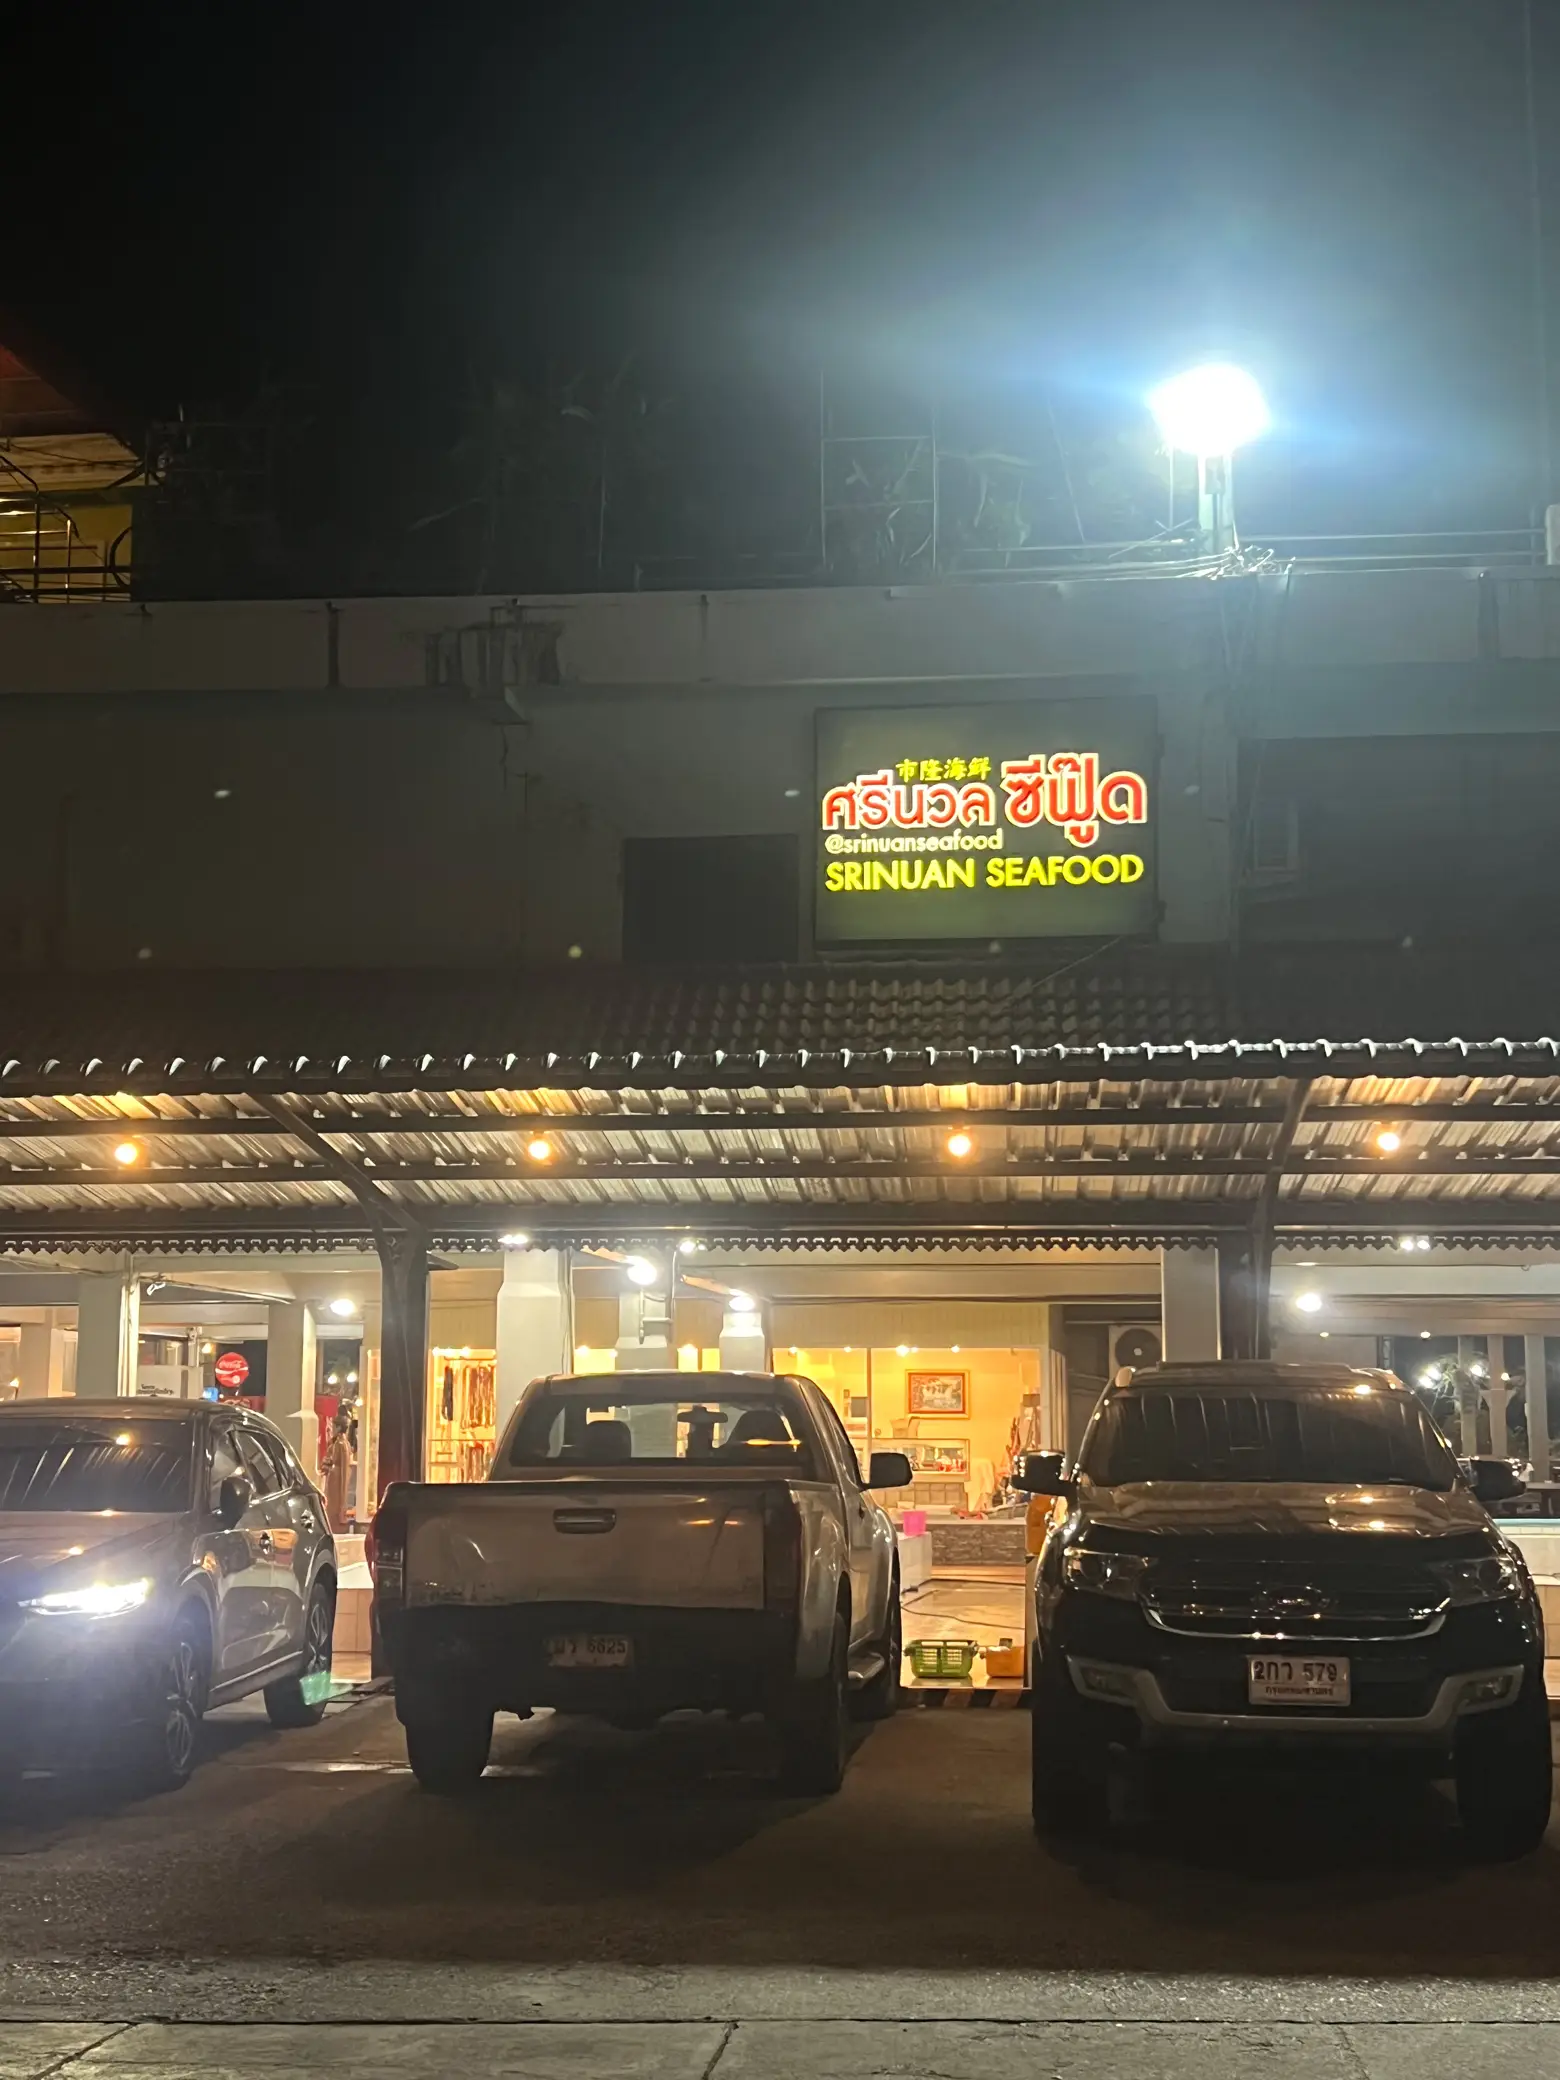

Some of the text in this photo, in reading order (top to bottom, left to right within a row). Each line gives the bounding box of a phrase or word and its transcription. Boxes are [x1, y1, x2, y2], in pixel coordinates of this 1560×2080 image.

[822, 769, 996, 831] ศรีนวล
[825, 828, 1003, 854] @srinuanseafood
[825, 854, 1144, 891] SRINUAN SEAFOOD
